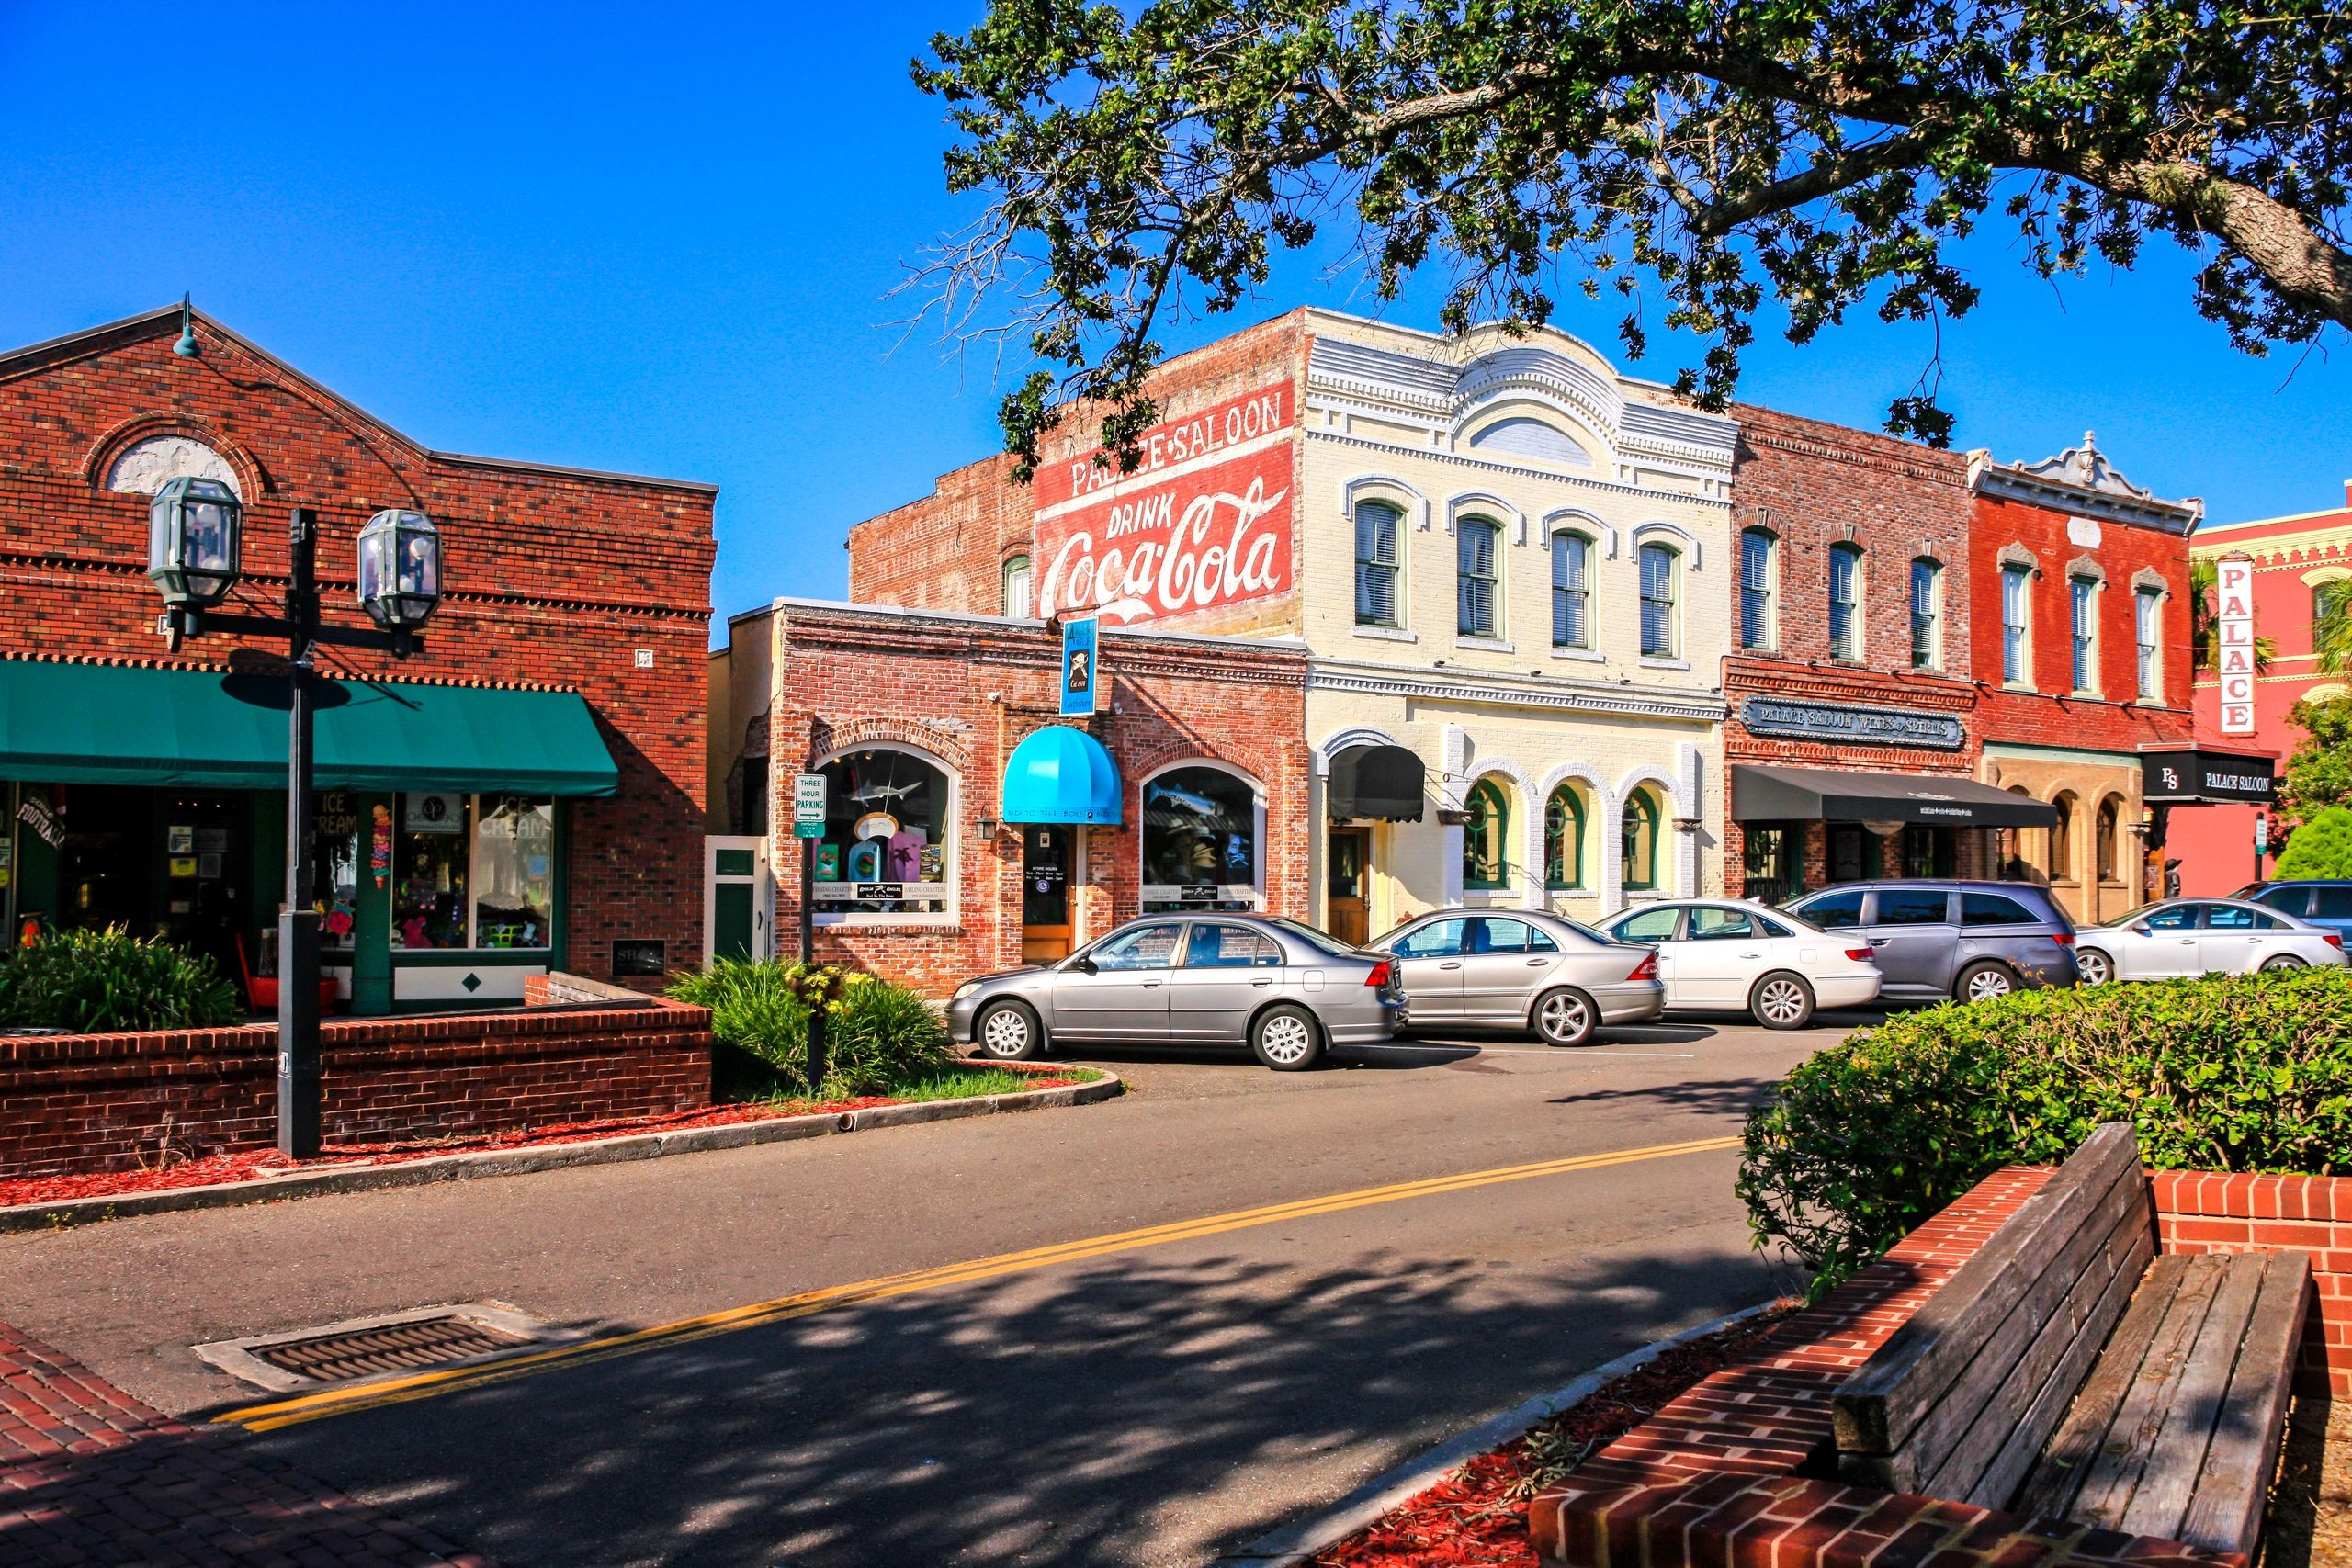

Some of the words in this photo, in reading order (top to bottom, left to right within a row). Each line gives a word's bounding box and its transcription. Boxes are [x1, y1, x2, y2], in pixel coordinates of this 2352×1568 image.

[1071, 433, 1166, 497] PALCE
[1173, 391, 1282, 459] SALOON
[1106, 492, 1176, 540] DRINK
[2223, 570, 2248, 726] PALACE
[1760, 707, 1804, 724] PALACE
[1808, 712, 1854, 728] SALOON
[1858, 716, 1894, 730] WINES
[1905, 720, 1948, 736] SPIRITS
[2206, 773, 2238, 789] PALACE
[2239, 776, 2269, 791] SALOON
[322, 794, 345, 813] ICE
[797, 800, 823, 808] PARKING
[479, 818, 548, 835] CRAM
